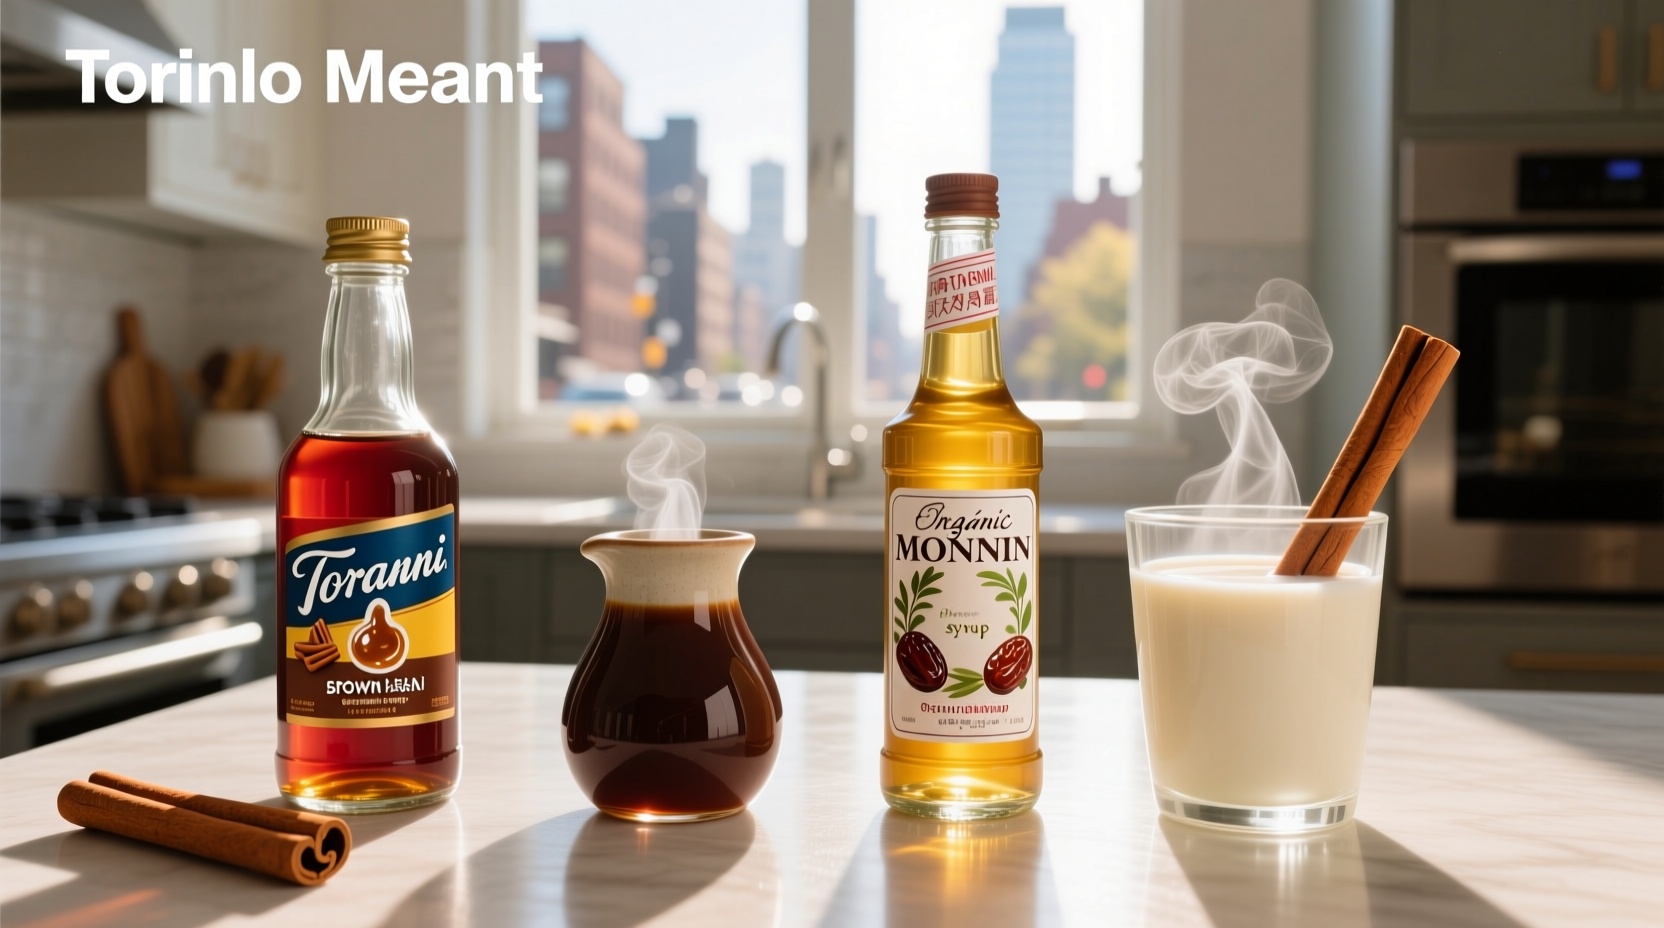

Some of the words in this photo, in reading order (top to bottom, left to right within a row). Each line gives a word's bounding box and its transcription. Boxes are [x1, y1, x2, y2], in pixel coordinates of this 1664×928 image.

[895, 534, 1031, 563] MONNIN
[292, 534, 446, 616] Toranni
[945, 623, 989, 639] syrup
